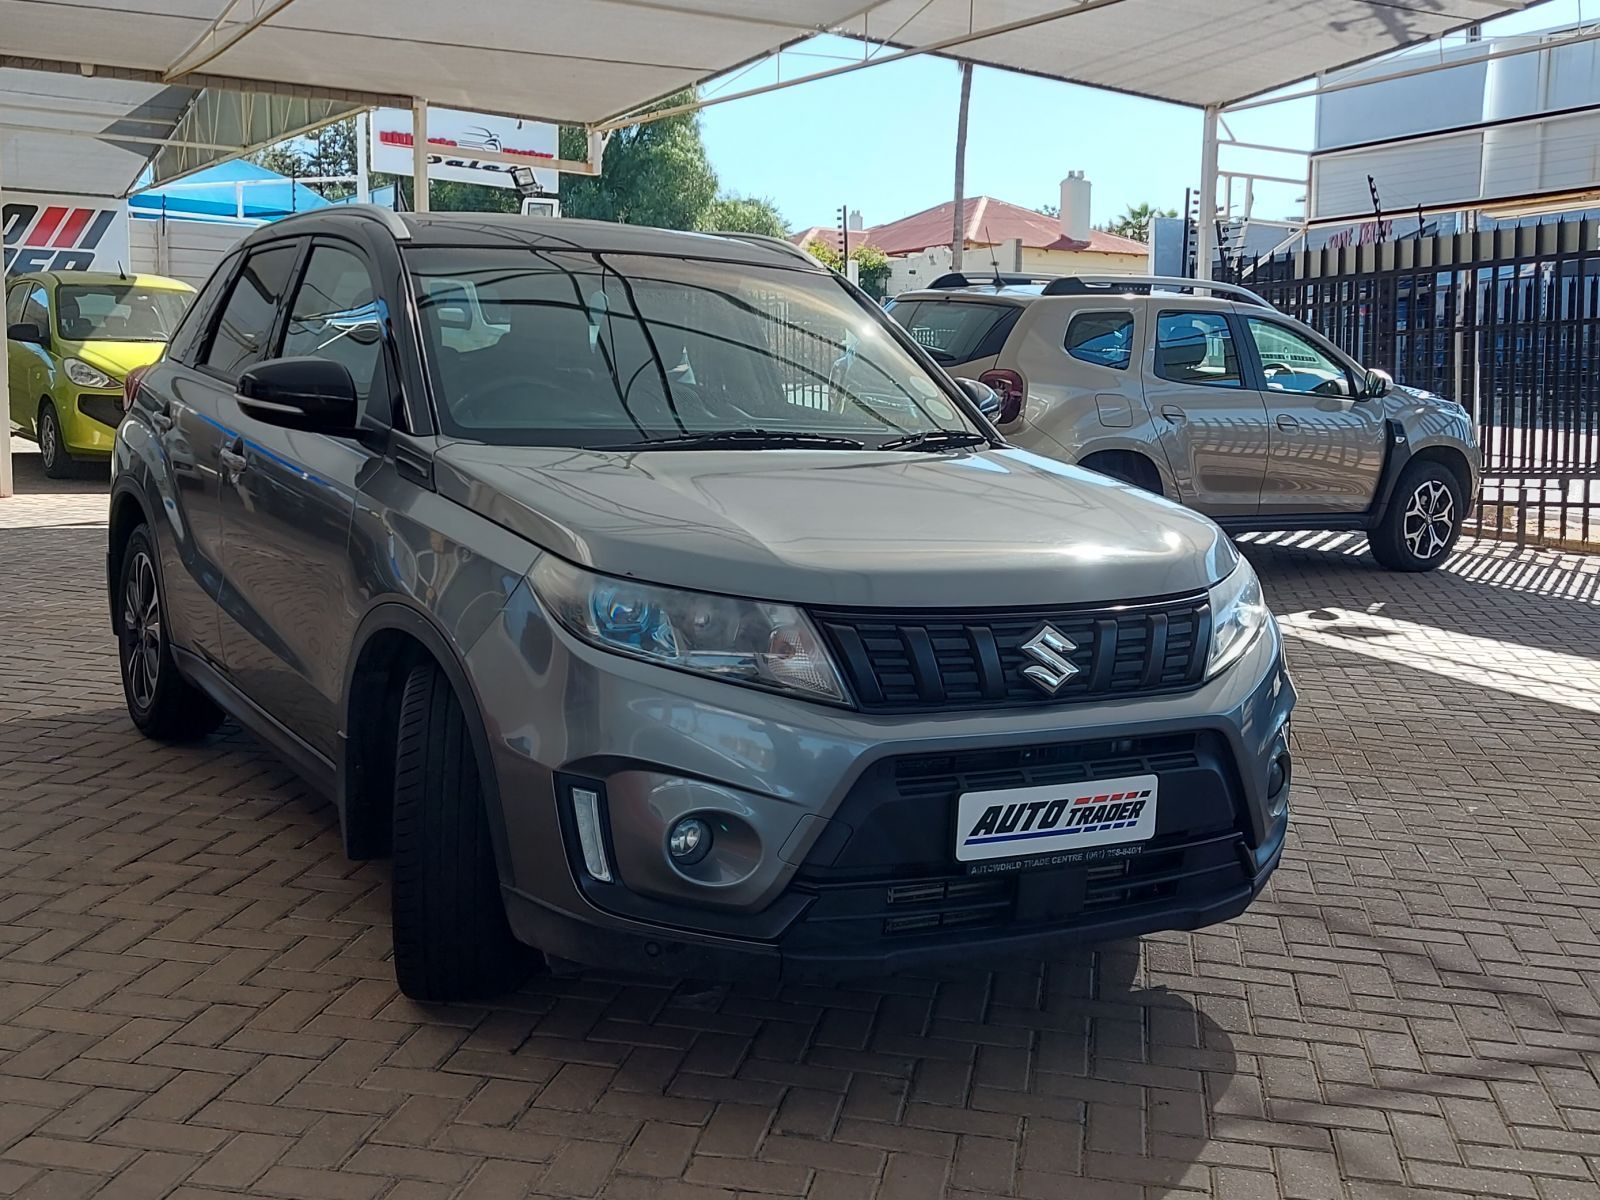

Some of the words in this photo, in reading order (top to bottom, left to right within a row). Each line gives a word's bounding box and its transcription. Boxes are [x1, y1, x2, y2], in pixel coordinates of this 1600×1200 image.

[969, 799, 1069, 837] AUTO
[1065, 799, 1147, 828] TRADER
[1024, 857, 1051, 869] TRADE
[1051, 852, 1084, 865] CENTRE
